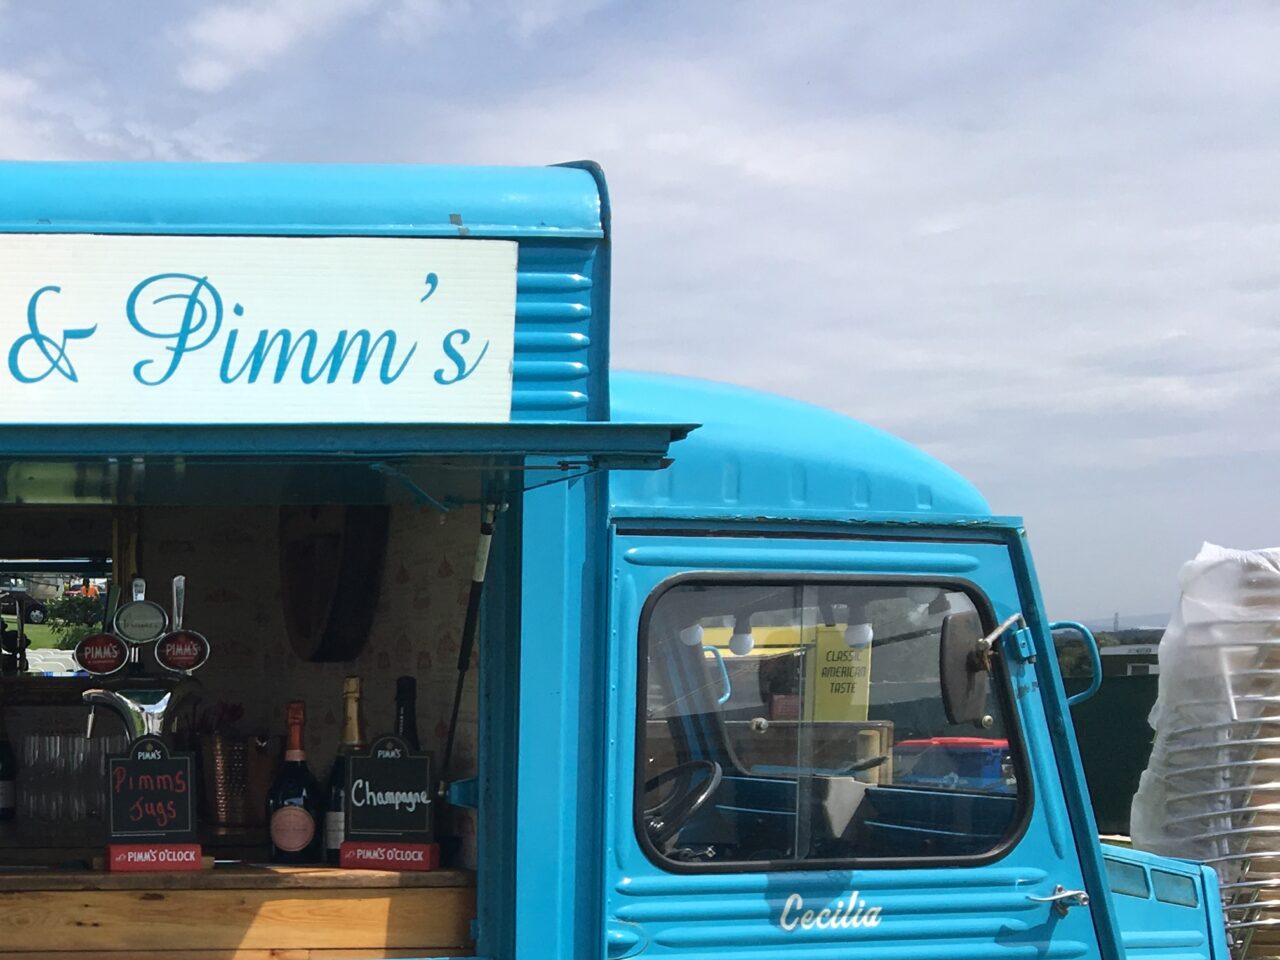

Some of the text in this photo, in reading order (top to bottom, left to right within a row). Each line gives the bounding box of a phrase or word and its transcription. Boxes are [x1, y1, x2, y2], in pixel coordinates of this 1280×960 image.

[7, 285, 97, 384] &
[125, 272, 489, 386] Pimm's
[84, 643, 118, 659] PIMM'S
[166, 641, 198, 656] PIMM'S
[821, 666, 866, 678] AMERICAN
[830, 682, 857, 694] TASTE
[137, 749, 162, 760] PIMM'S
[377, 748, 401, 759] PIMM'S
[113, 766, 186, 793] Pimms
[351, 778, 431, 812] Champagne
[129, 796, 177, 827] Jugs
[127, 849, 158, 862] PIMM'S
[158, 849, 196, 862] O'CLOCK
[356, 848, 385, 860] PIMM'S
[386, 848, 424, 861] O'CLOCK
[780, 890, 883, 931] Cecilia
